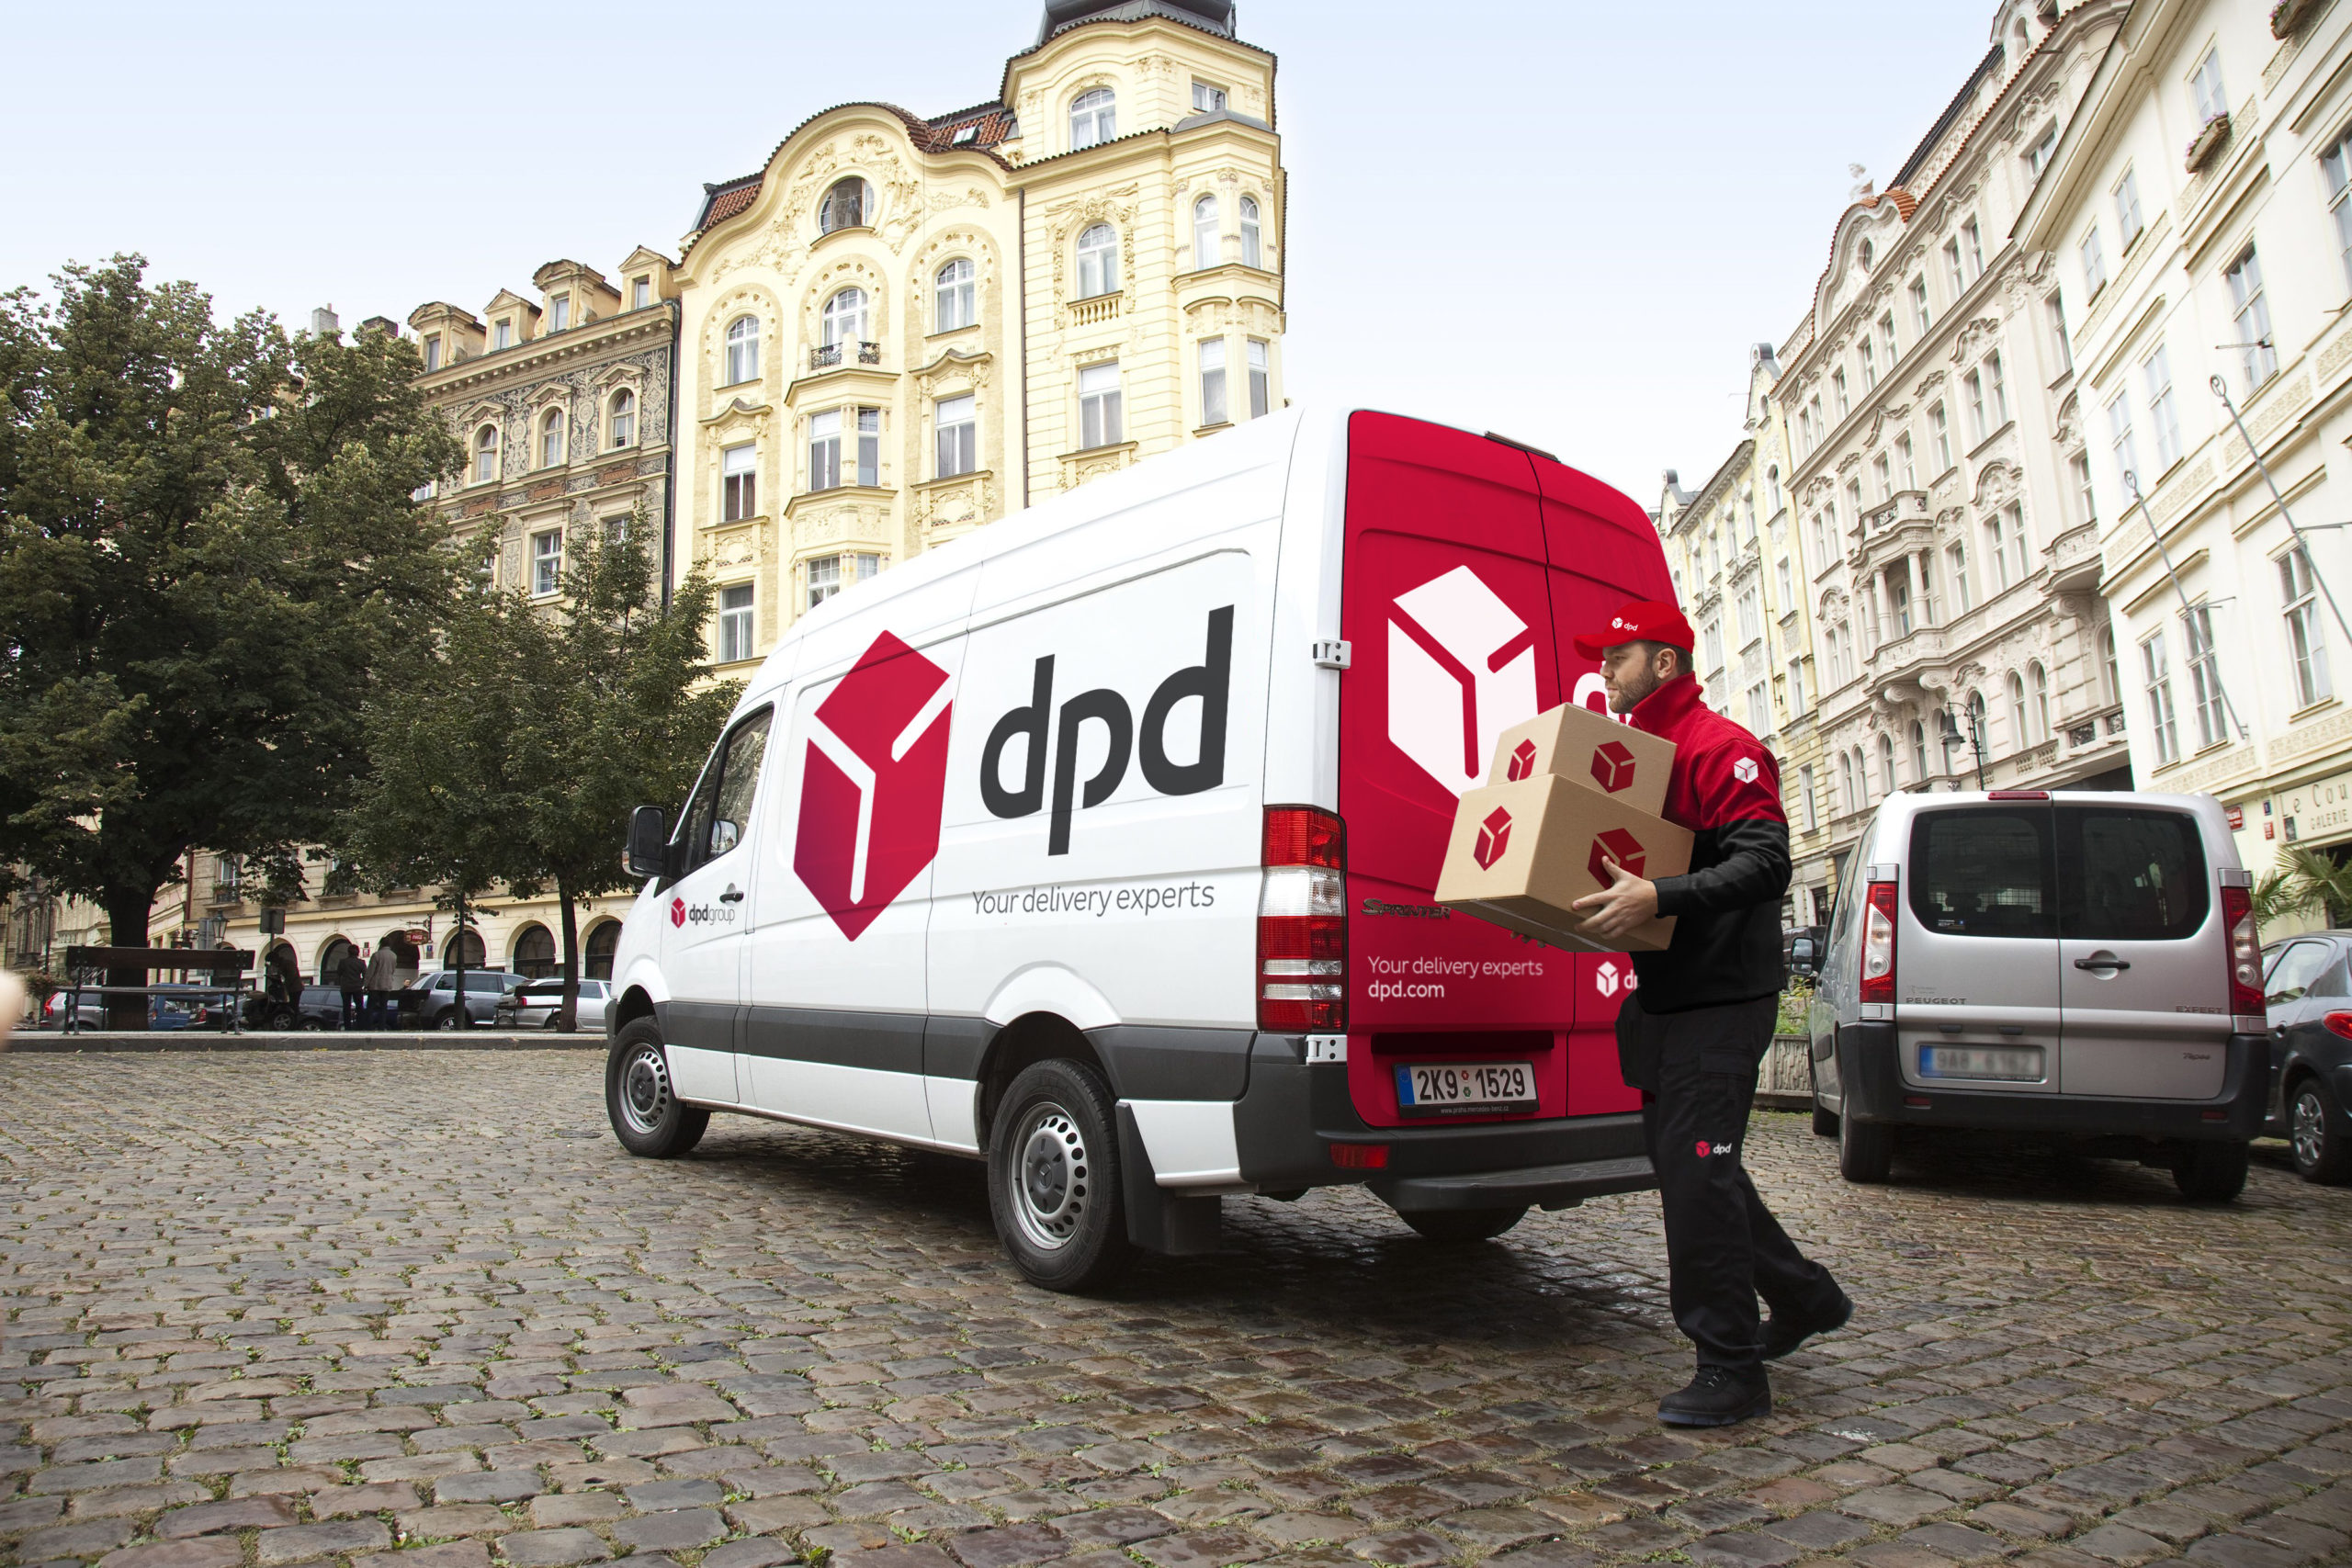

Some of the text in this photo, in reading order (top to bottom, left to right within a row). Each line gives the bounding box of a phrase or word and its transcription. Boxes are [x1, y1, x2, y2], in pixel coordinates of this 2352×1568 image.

[1623, 622, 1639, 632] dpd
[980, 604, 1234, 856] dpd
[2278, 794, 2301, 818] Le
[972, 881, 1215, 917] Your delivery experts
[689, 903, 736, 926] dpdgroup
[1367, 955, 1544, 979] Your delivery experts
[1368, 979, 1445, 1002] dpd.com
[1905, 997, 1968, 1005] PEUGEOT
[1417, 1067, 1527, 1101] 2K9 1529
[1713, 1142, 1733, 1156] dpd
